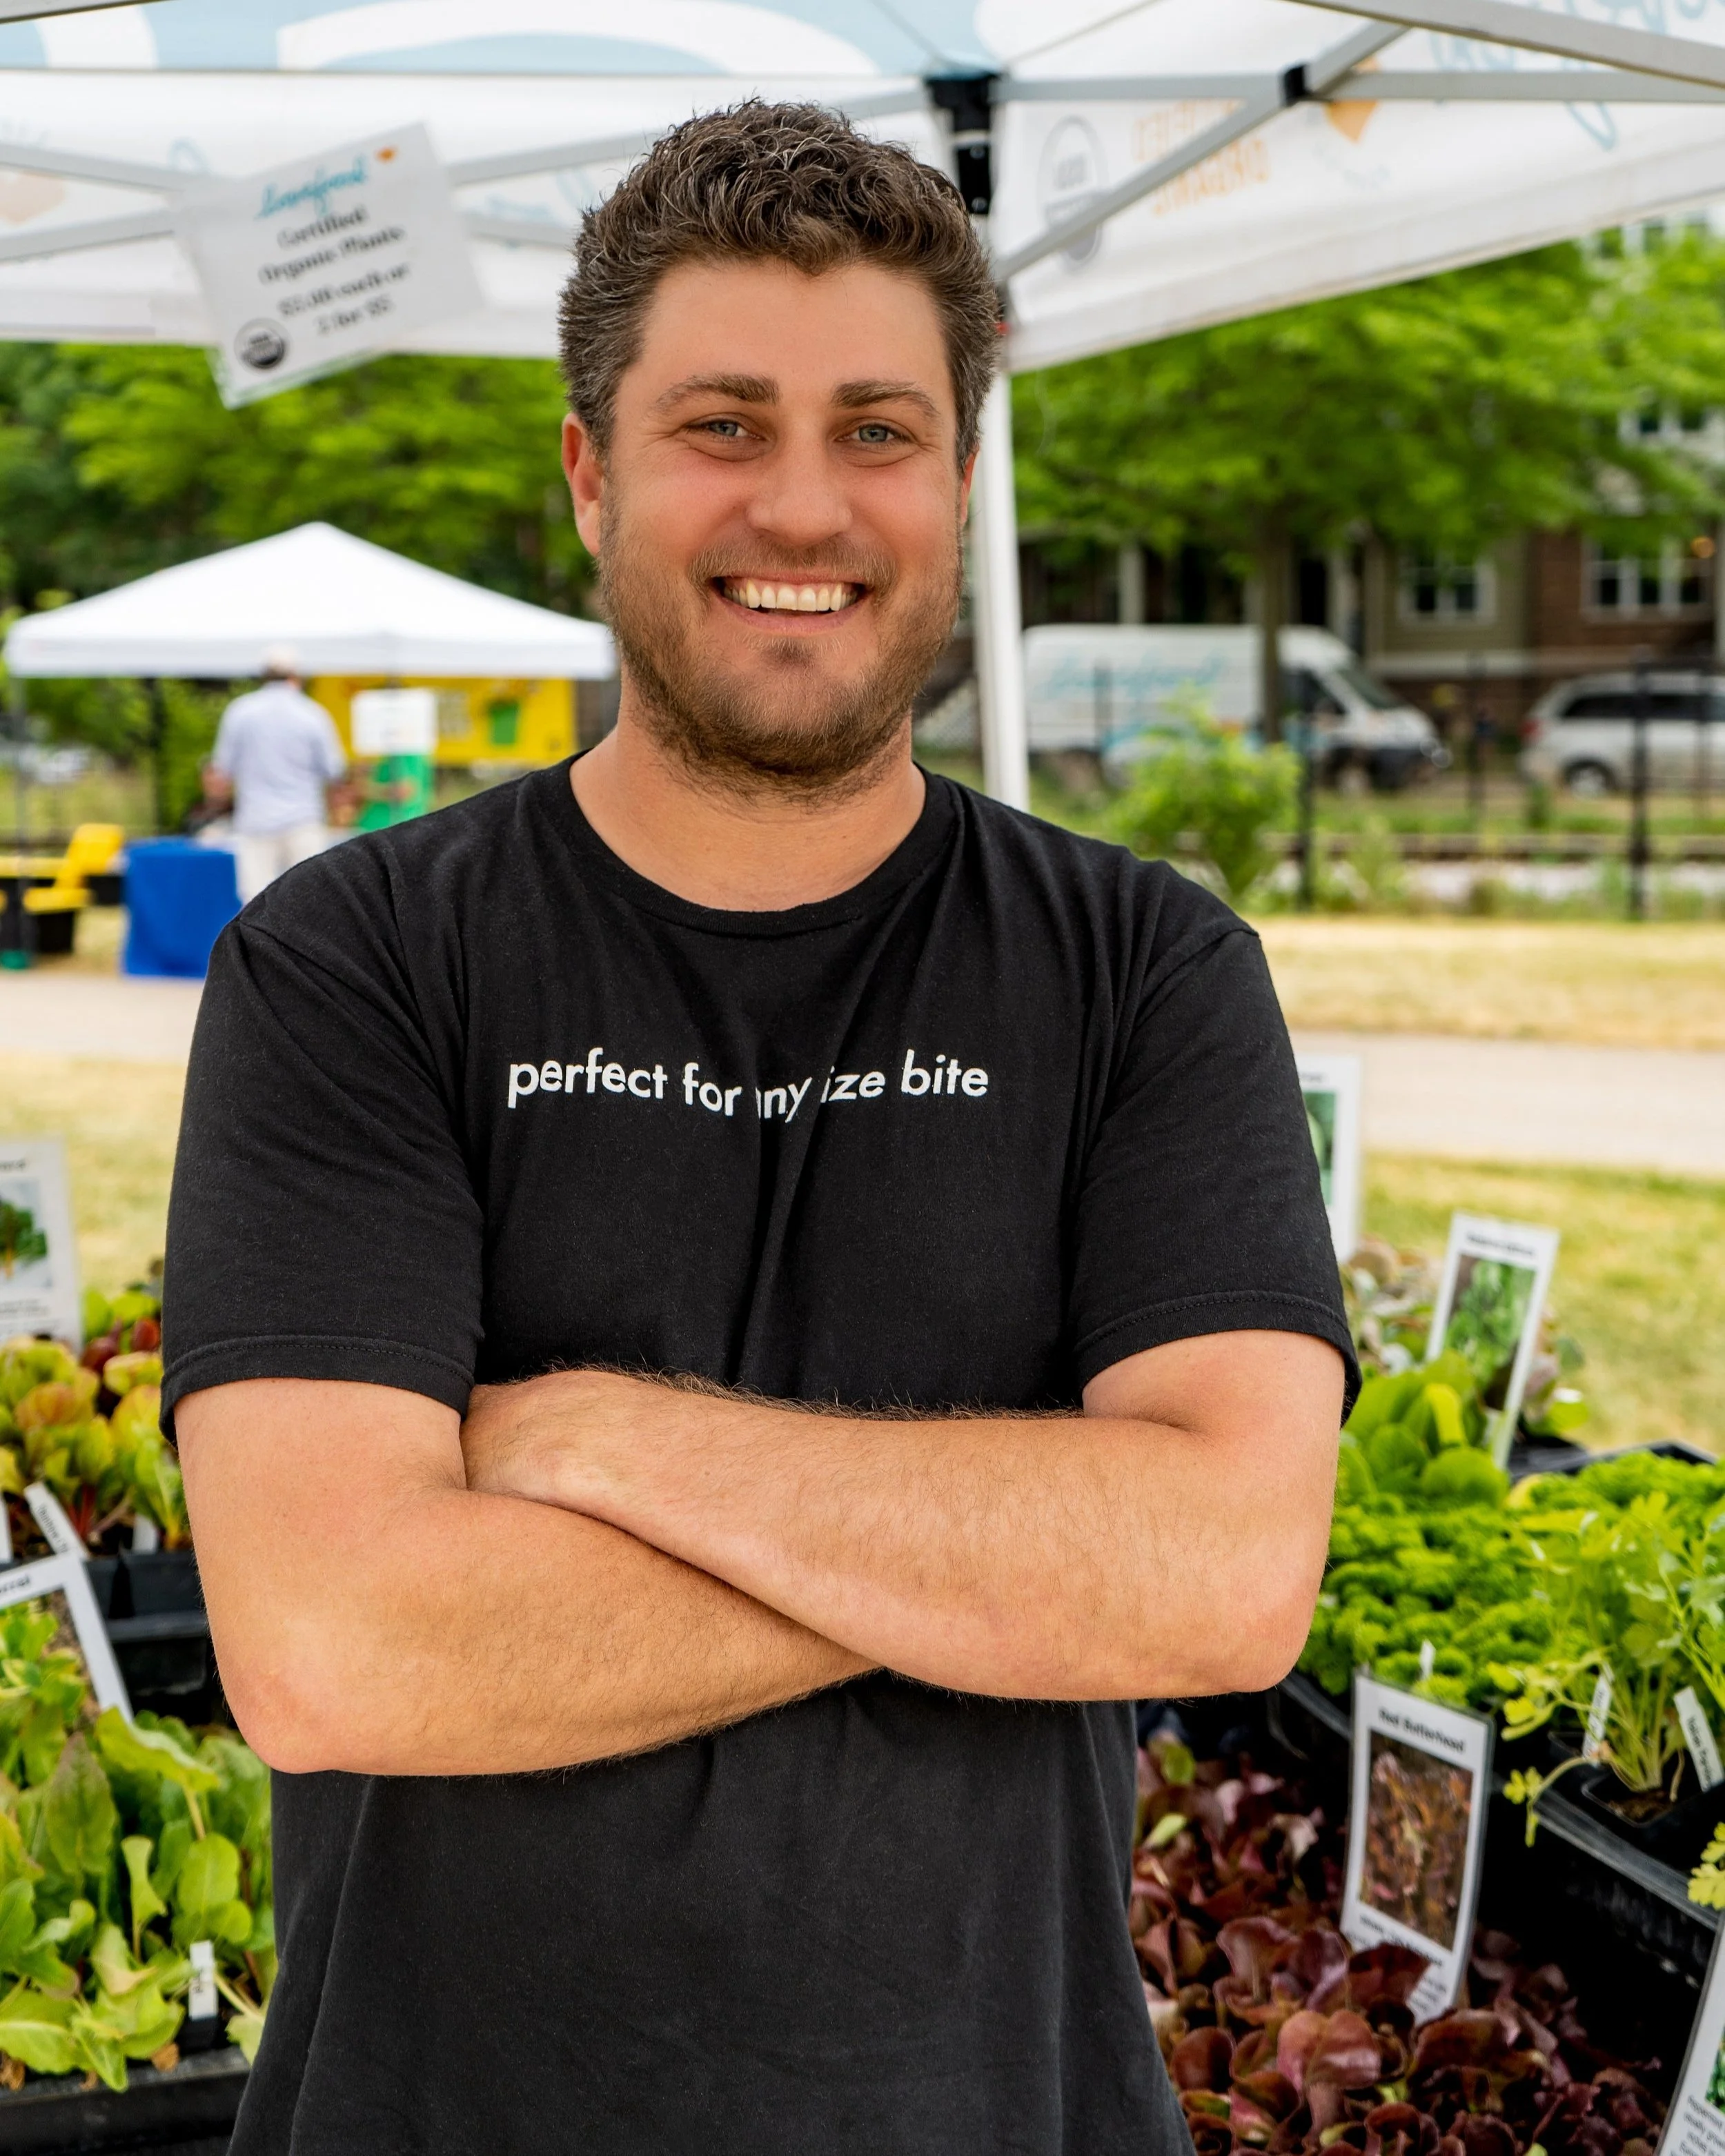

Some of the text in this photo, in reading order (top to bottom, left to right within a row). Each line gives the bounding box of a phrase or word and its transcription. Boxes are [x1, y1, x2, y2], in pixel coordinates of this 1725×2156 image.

[258, 250, 338, 285] Organic
[508, 1047, 668, 1109] perfect
[684, 1063, 743, 1116] for
[820, 1065, 887, 1103] ize
[900, 1049, 989, 1097] bite
